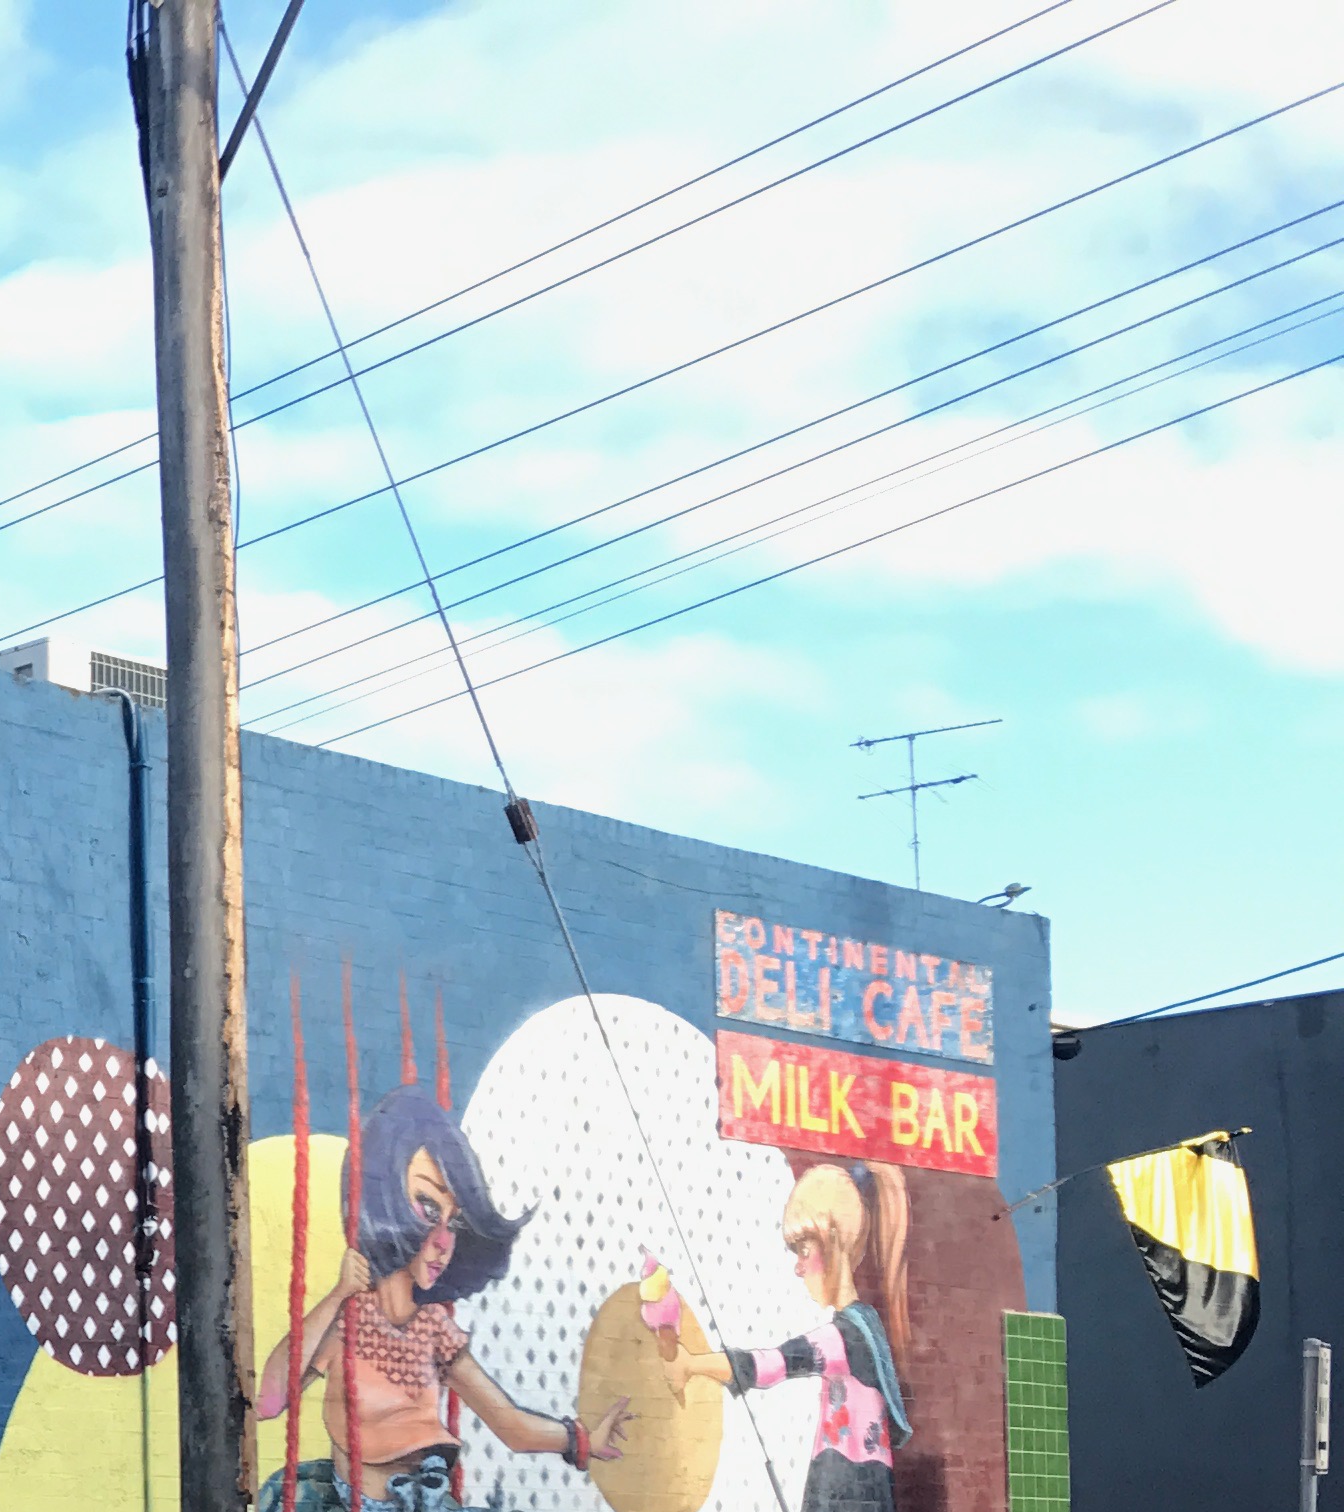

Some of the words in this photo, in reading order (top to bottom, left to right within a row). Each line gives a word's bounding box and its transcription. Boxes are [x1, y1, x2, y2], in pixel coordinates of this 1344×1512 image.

[716, 910, 989, 995] CONTINENTAL
[720, 949, 832, 1031] DELI
[864, 979, 989, 1059] CAFE
[730, 1053, 866, 1139] MILK
[890, 1081, 986, 1157] BAR
